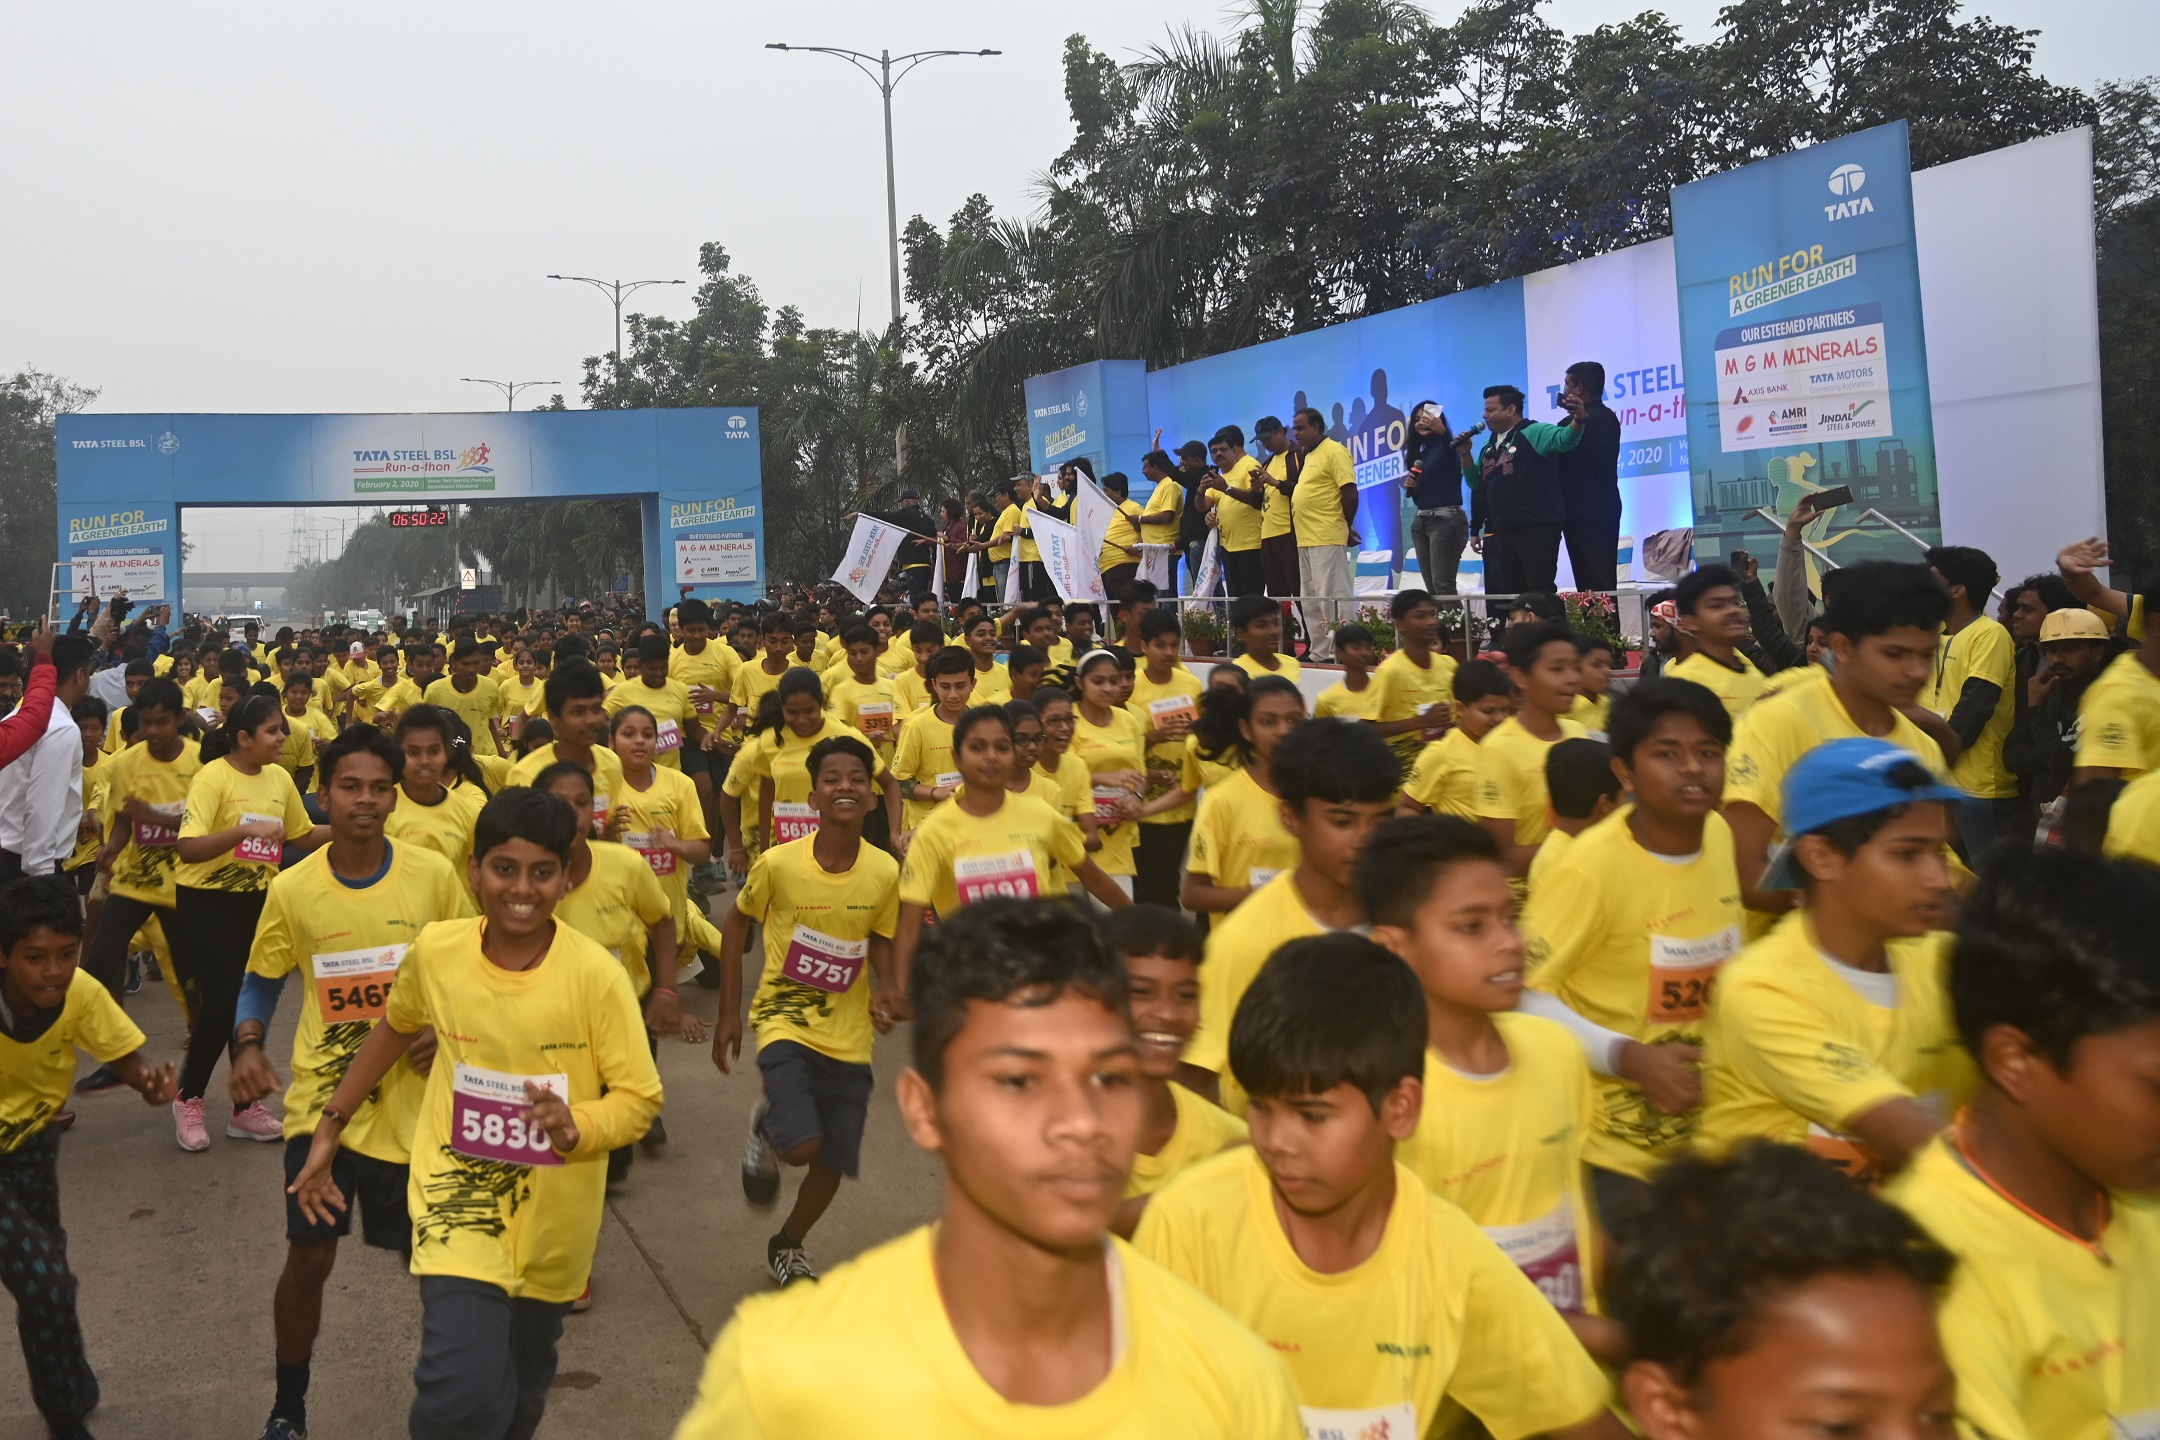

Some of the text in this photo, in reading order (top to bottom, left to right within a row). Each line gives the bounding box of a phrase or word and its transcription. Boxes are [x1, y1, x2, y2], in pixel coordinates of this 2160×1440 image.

[1825, 197, 1873, 222] TATA
[1729, 245, 1824, 297] RUN FOR
[1733, 259, 1854, 314] A GREENER EARTH
[1741, 310, 1855, 343] OUR ESTEEMED PARTNERS
[1725, 336, 1878, 376] M G M MINERALS
[1614, 364, 1684, 399] STEEL
[1809, 367, 1873, 384] TATA MOTORS
[1748, 384, 1788, 397] AXIS BANK
[1809, 380, 1873, 394] Connecting Aspirations
[1034, 403, 1070, 418] TATA STEEL BSL
[1782, 407, 1806, 419] AMRI
[1818, 412, 1853, 425] JINDAL
[1826, 422, 1844, 431] STEEL
[1851, 419, 1875, 428] POWER
[72, 439, 146, 449] TATA STEEL BSL
[725, 431, 750, 439] TATA
[1045, 423, 1076, 447] RUN FOR
[1051, 438, 1070, 455] GREENER
[1070, 434, 1084, 446] EARTH
[1374, 418, 1410, 457] FO
[354, 449, 457, 461] TATA STEEL BSL
[1628, 446, 1662, 466] 2020
[385, 462, 450, 472] Run-a-thon
[1357, 456, 1400, 487] EENER
[357, 481, 390, 489] February
[671, 497, 735, 517] RUN FOR
[70, 510, 145, 532] RUN FOR
[393, 512, 446, 526] 06:50:22
[673, 507, 753, 527] A GREENER EARTH
[72, 521, 165, 542] A GREENER EARTH
[99, 548, 124, 556] ESTEEMED
[125, 547, 150, 555] PARTNERS
[709, 543, 752, 551] MINERALS
[110, 559, 160, 568] MINERALS
[242, 837, 279, 856] 5624
[802, 932, 817, 943] TATA
[818, 939, 834, 948] STEEL
[835, 944, 846, 952] BSL
[341, 959, 360, 967] STEEL
[796, 953, 853, 985] 5751
[541, 1043, 557, 1051] TATA
[463, 1074, 527, 1093] TATA STEEL BSL
[462, 1108, 551, 1152] 5830
